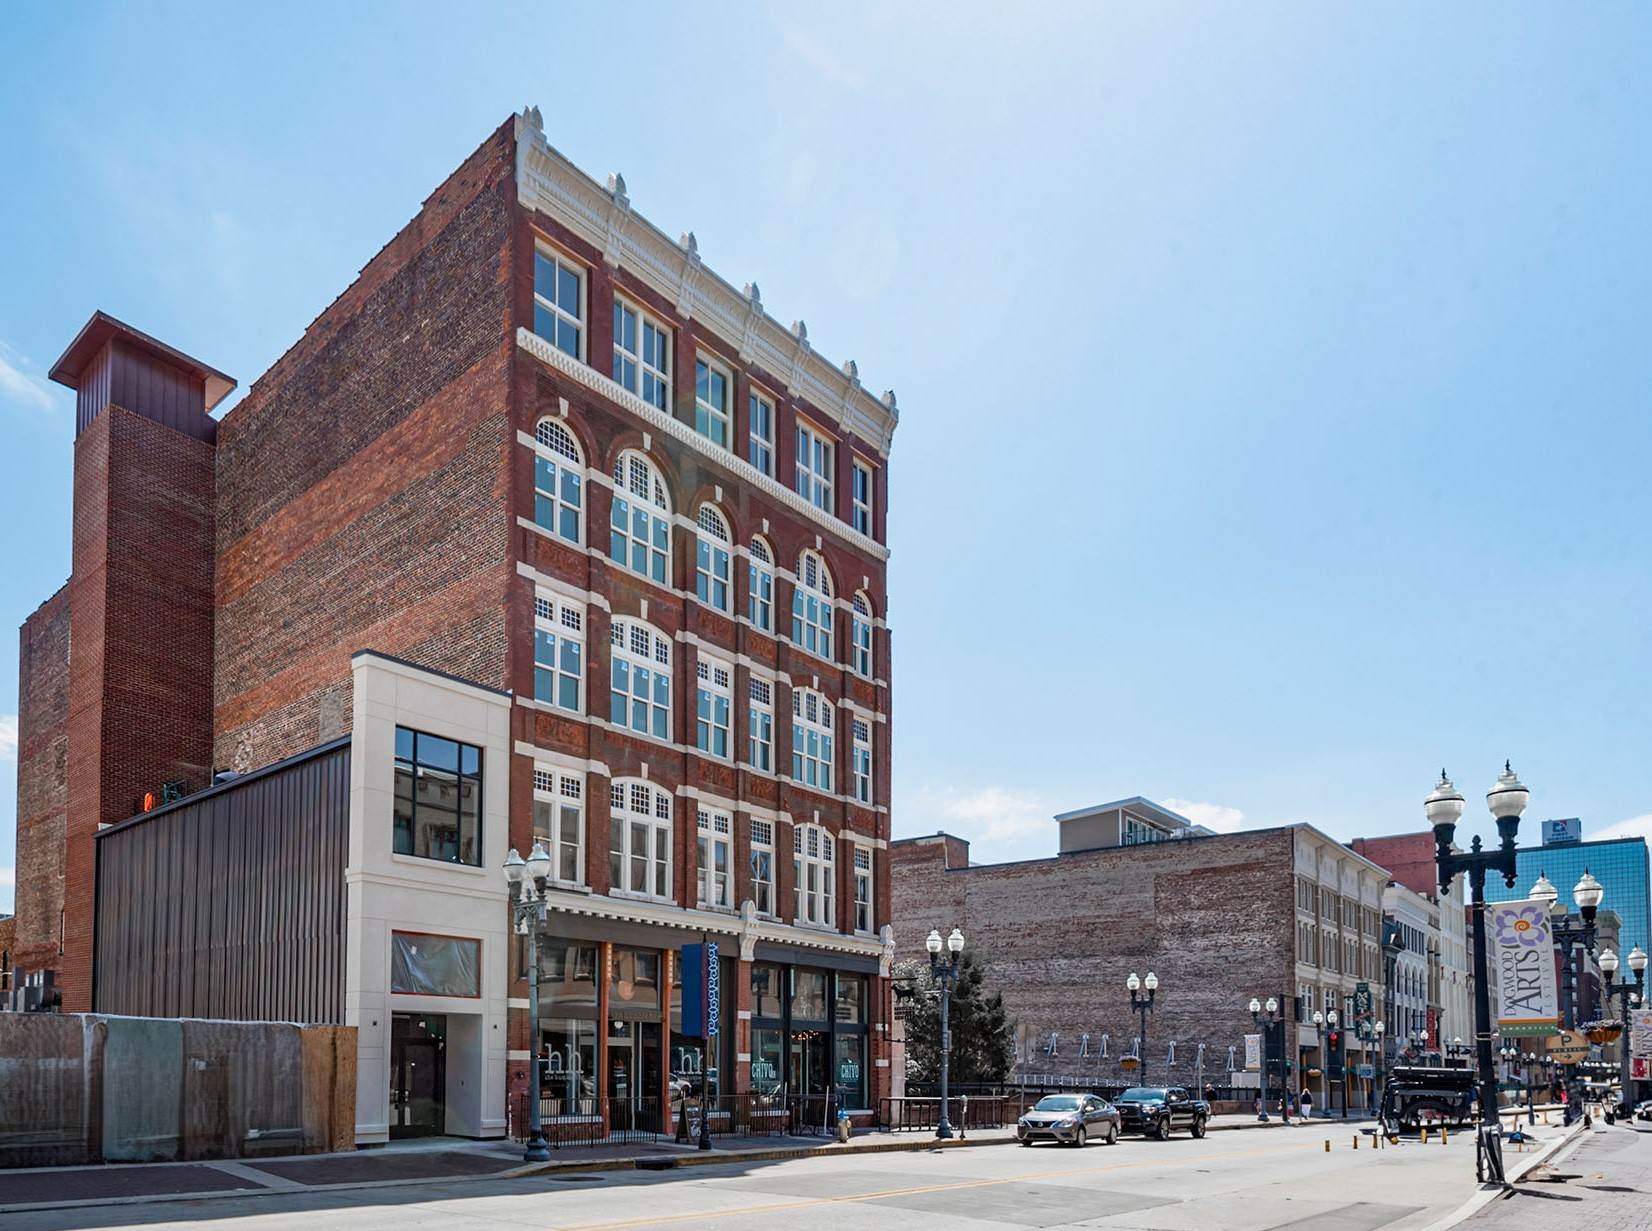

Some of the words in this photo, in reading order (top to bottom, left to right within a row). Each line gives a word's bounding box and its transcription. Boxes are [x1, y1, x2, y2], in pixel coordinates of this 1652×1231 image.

[1501, 951, 1516, 1016] DOGWOOD
[1509, 949, 1543, 1015] ARTS
[1561, 1035, 1572, 1046] P
[841, 1064, 860, 1079] CHIVO
